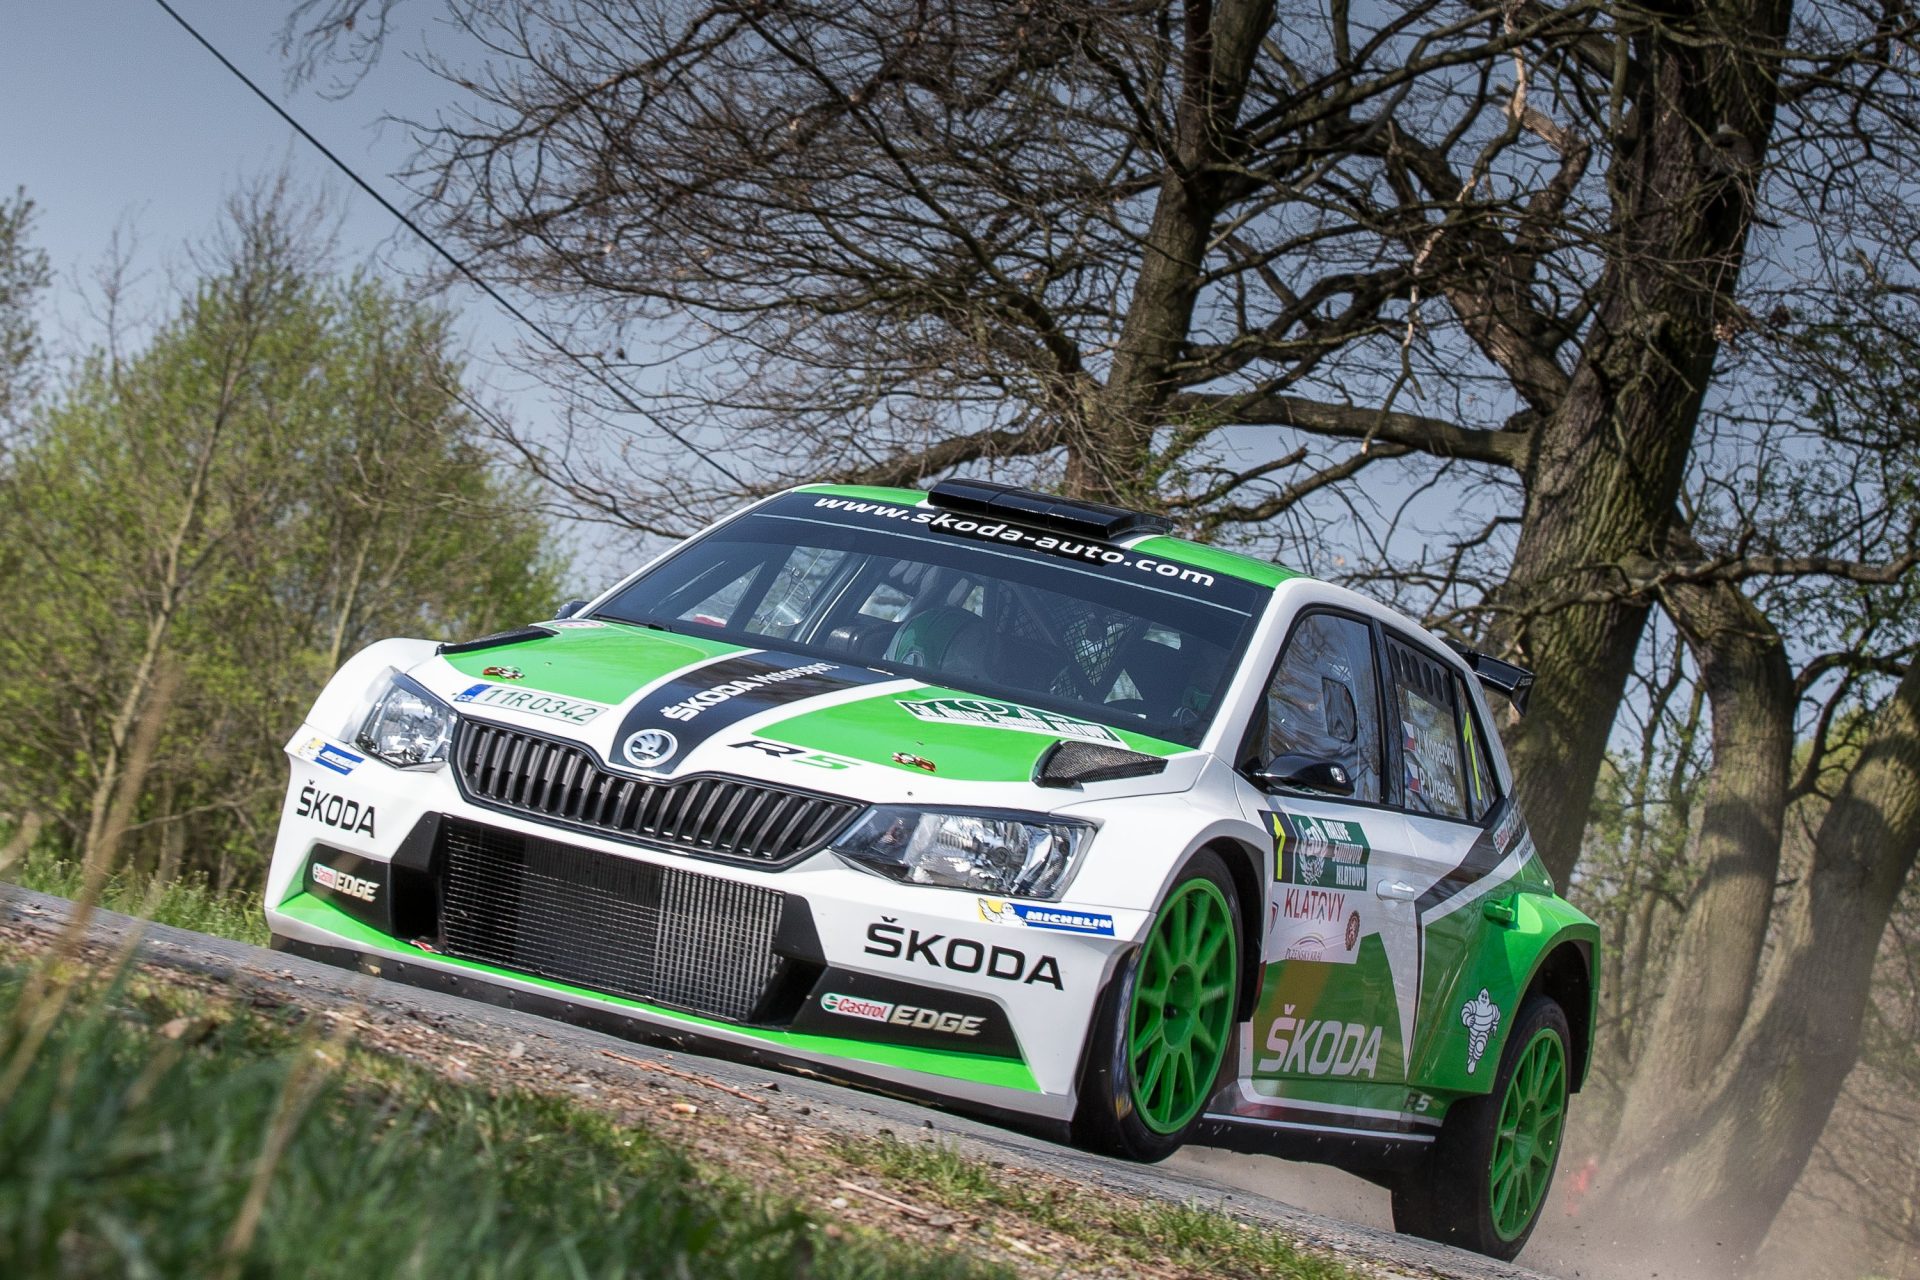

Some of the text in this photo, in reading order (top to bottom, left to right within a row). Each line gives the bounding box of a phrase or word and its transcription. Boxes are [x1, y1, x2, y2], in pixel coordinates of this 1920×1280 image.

[814, 496, 1215, 587] www.skoda-auto.com
[660, 677, 765, 722] ŠKODA
[727, 740, 862, 770] R5
[296, 779, 376, 838] ŠKODA
[335, 871, 380, 902] EDGE
[1335, 864, 1365, 888] KLATOVY
[1026, 910, 1112, 929] MICHELIN
[1284, 888, 1346, 923] KLATOVY
[864, 916, 1064, 991] ŠKODA
[837, 998, 987, 1036] Castrol EDGE
[1258, 1004, 1383, 1079] ŠKODA
